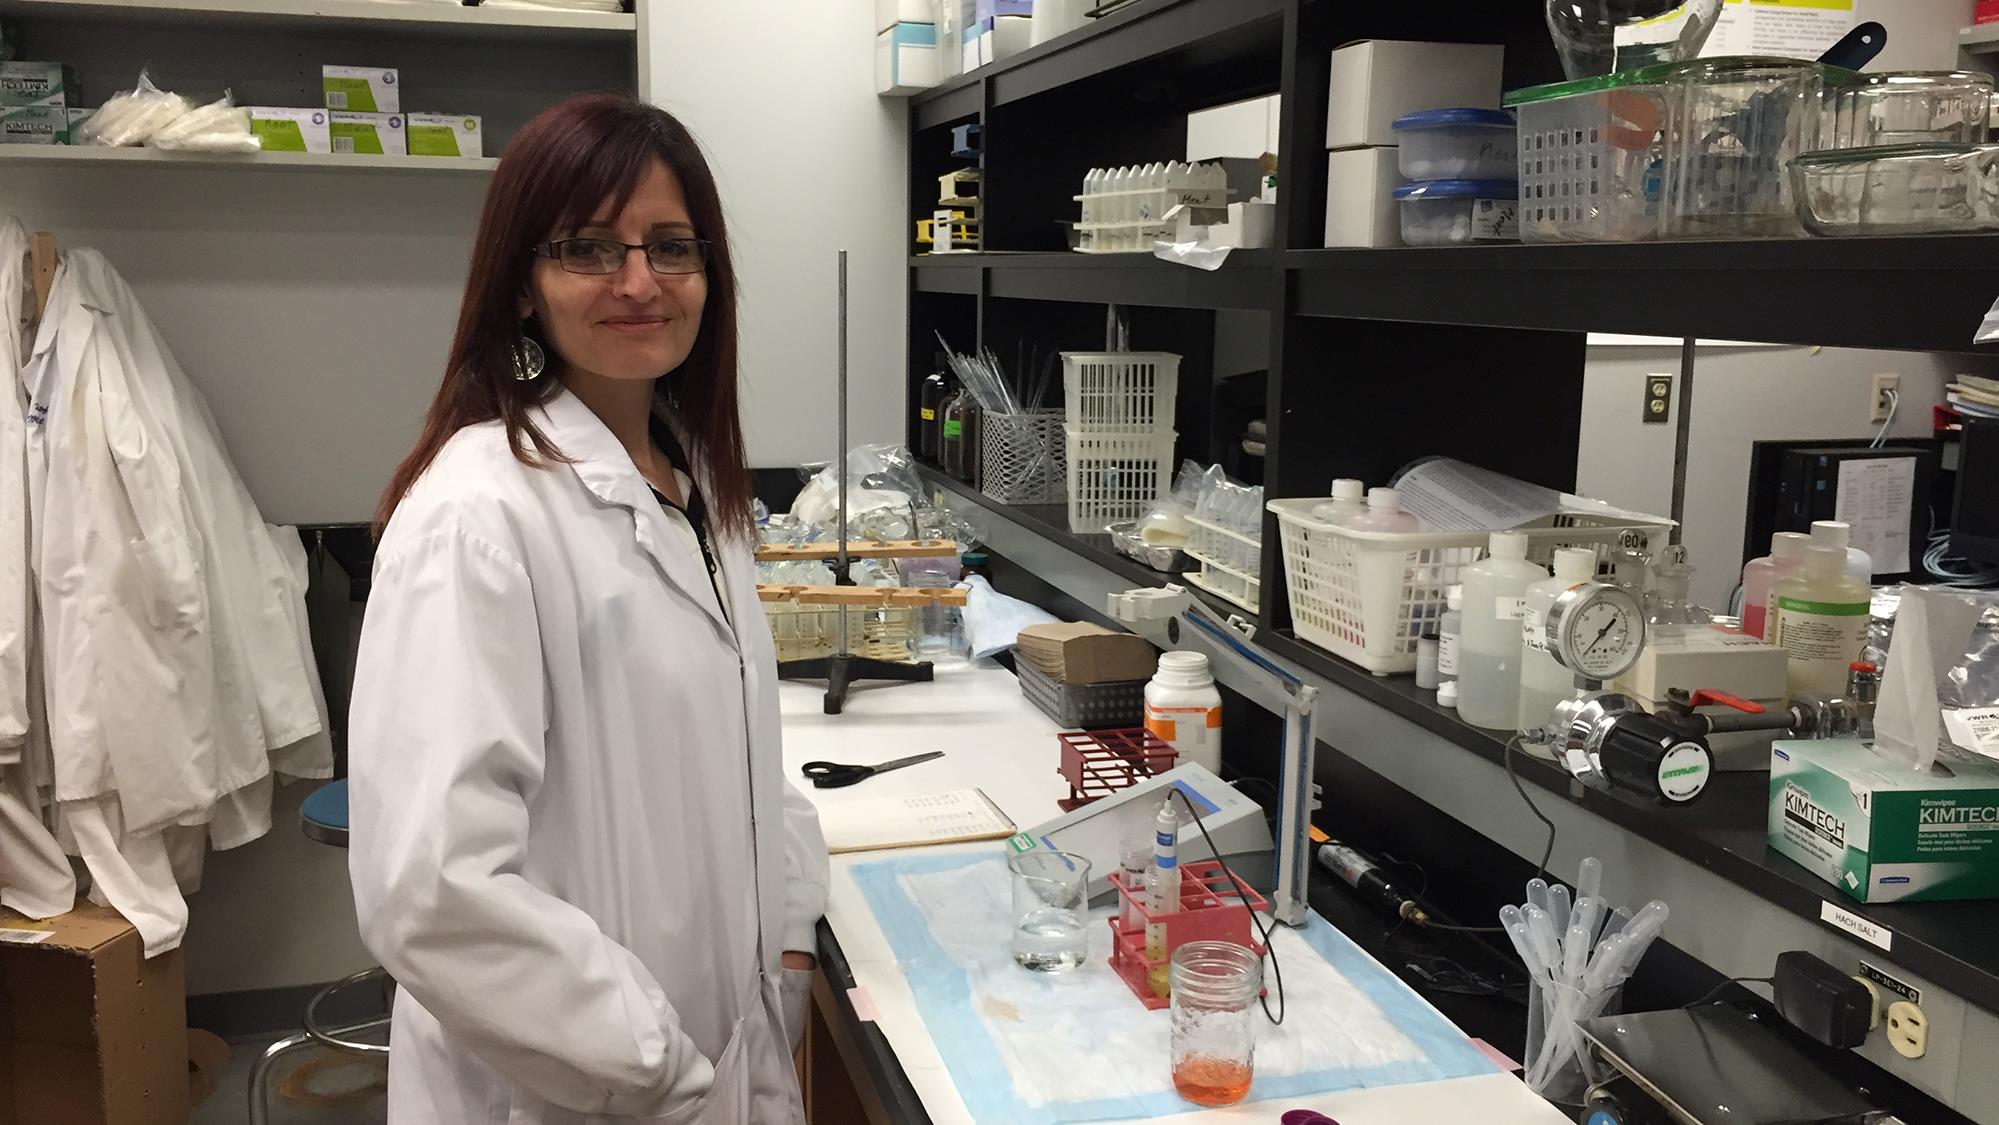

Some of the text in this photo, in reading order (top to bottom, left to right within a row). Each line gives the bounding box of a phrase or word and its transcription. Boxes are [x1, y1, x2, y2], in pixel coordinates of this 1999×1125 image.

[6, 122, 53, 131] KIMTECH
[1675, 551, 1685, 564] 12
[1785, 791, 1845, 838] KIMTECH
[1920, 807, 1999, 823] KIMTEC
[1836, 912, 1878, 938] HACH SALT
